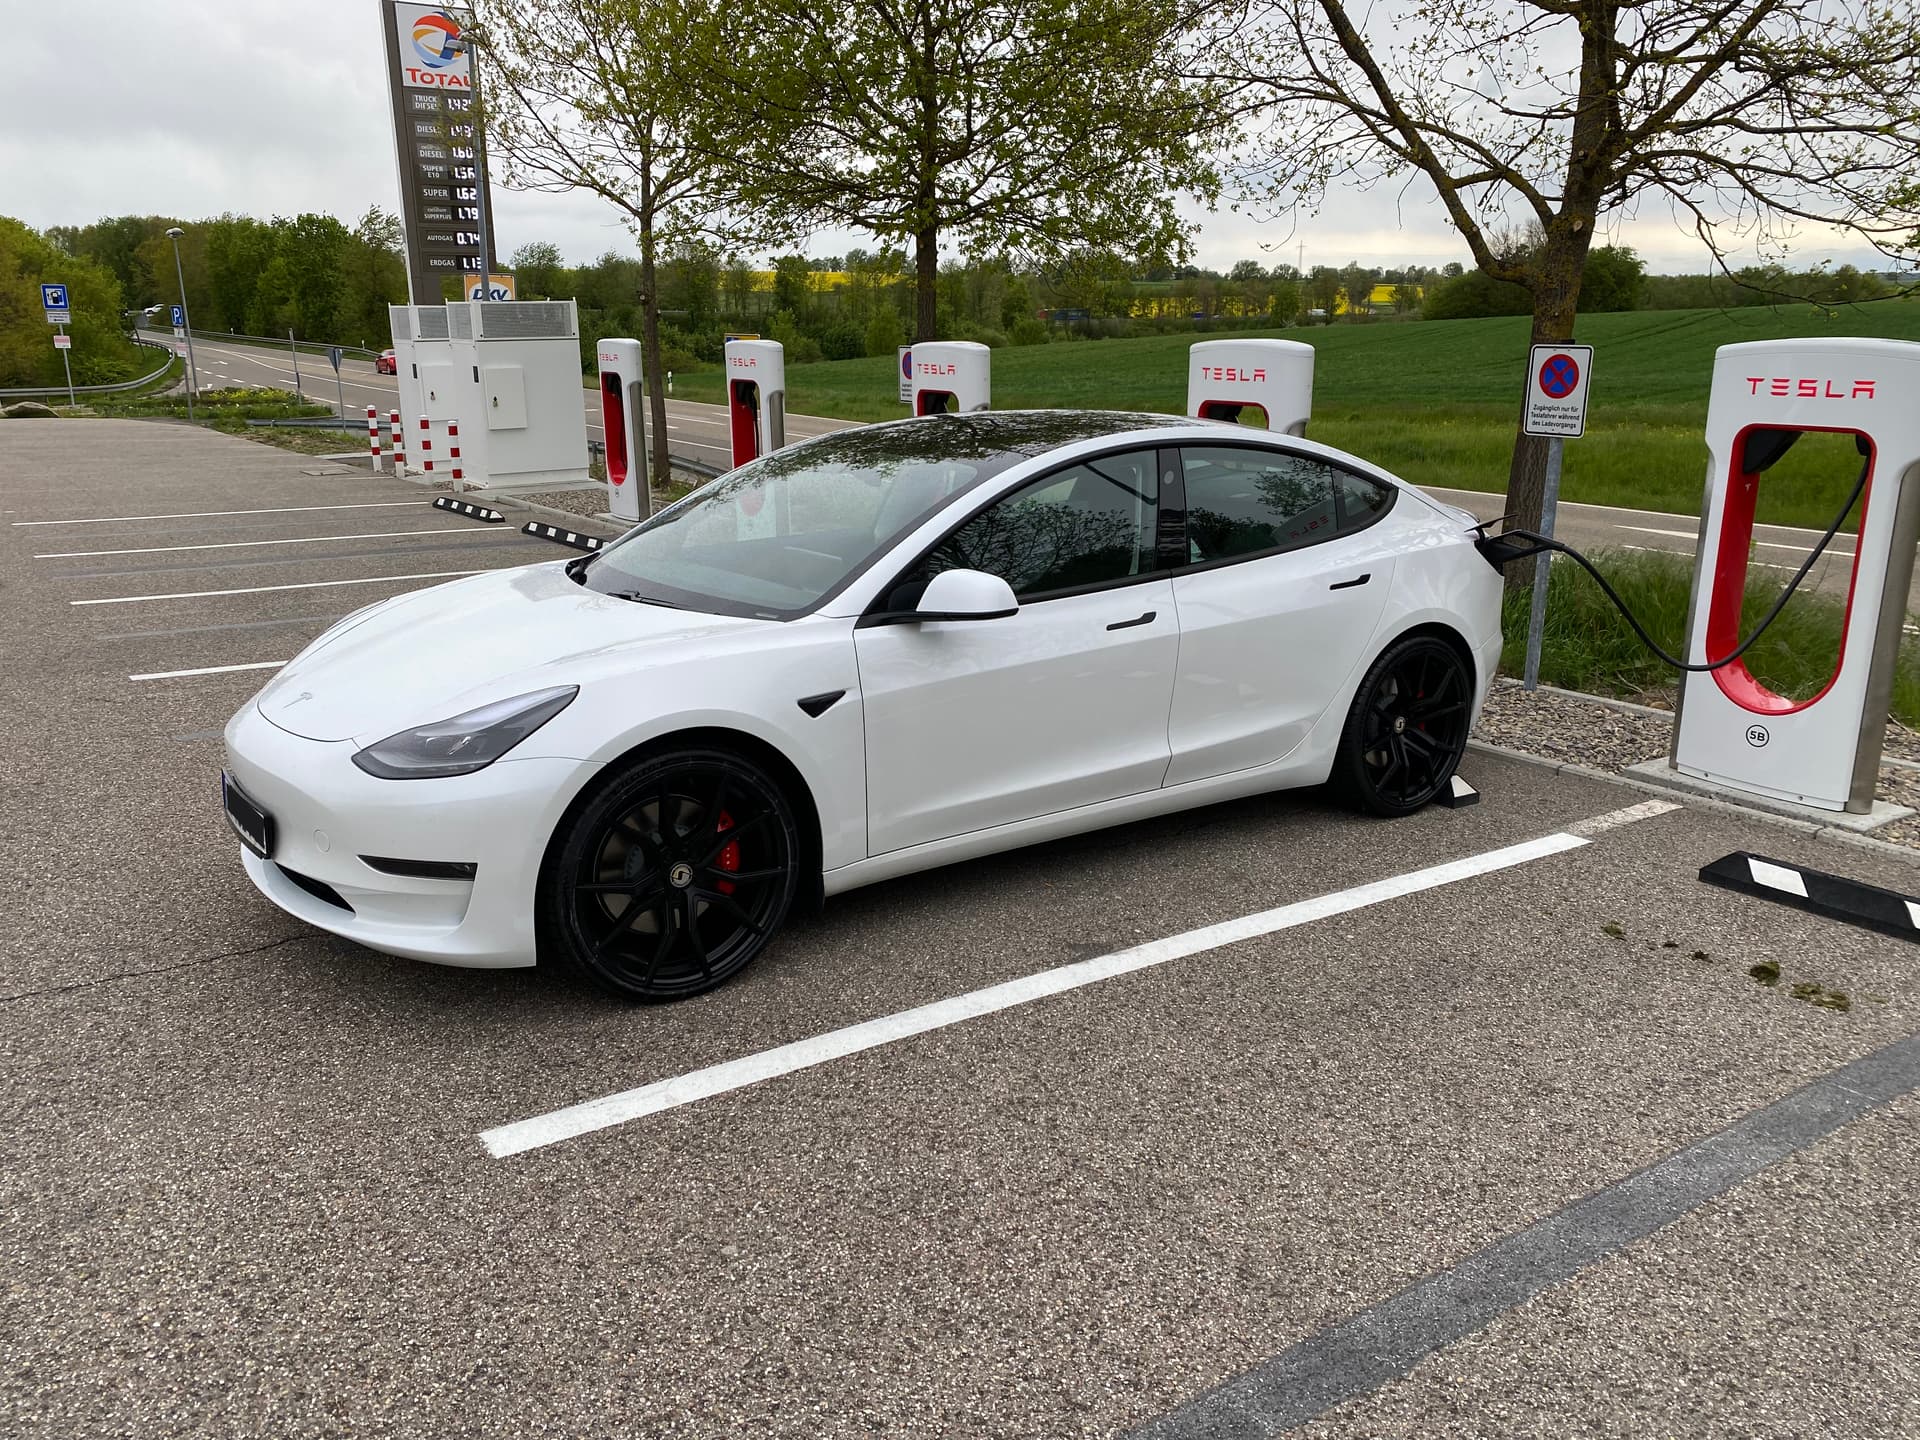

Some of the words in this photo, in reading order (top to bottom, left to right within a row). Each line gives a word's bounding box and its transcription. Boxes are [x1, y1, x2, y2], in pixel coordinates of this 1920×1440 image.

[419, 150, 444, 159] DIESEL
[423, 188, 448, 197] SUPER
[456, 187, 477, 200] 1.62
[458, 207, 479, 220] 1.79
[729, 357, 757, 367] TESLA
[917, 363, 956, 375] TESLA
[1202, 367, 1266, 382] TESLA
[1746, 377, 1877, 399] TESLA
[1533, 404, 1560, 412] Zugänglich
[1531, 411, 1557, 419] Teslafahrer
[1542, 421, 1576, 429] Ladevorgangs
[1749, 730, 1765, 741] 5B
